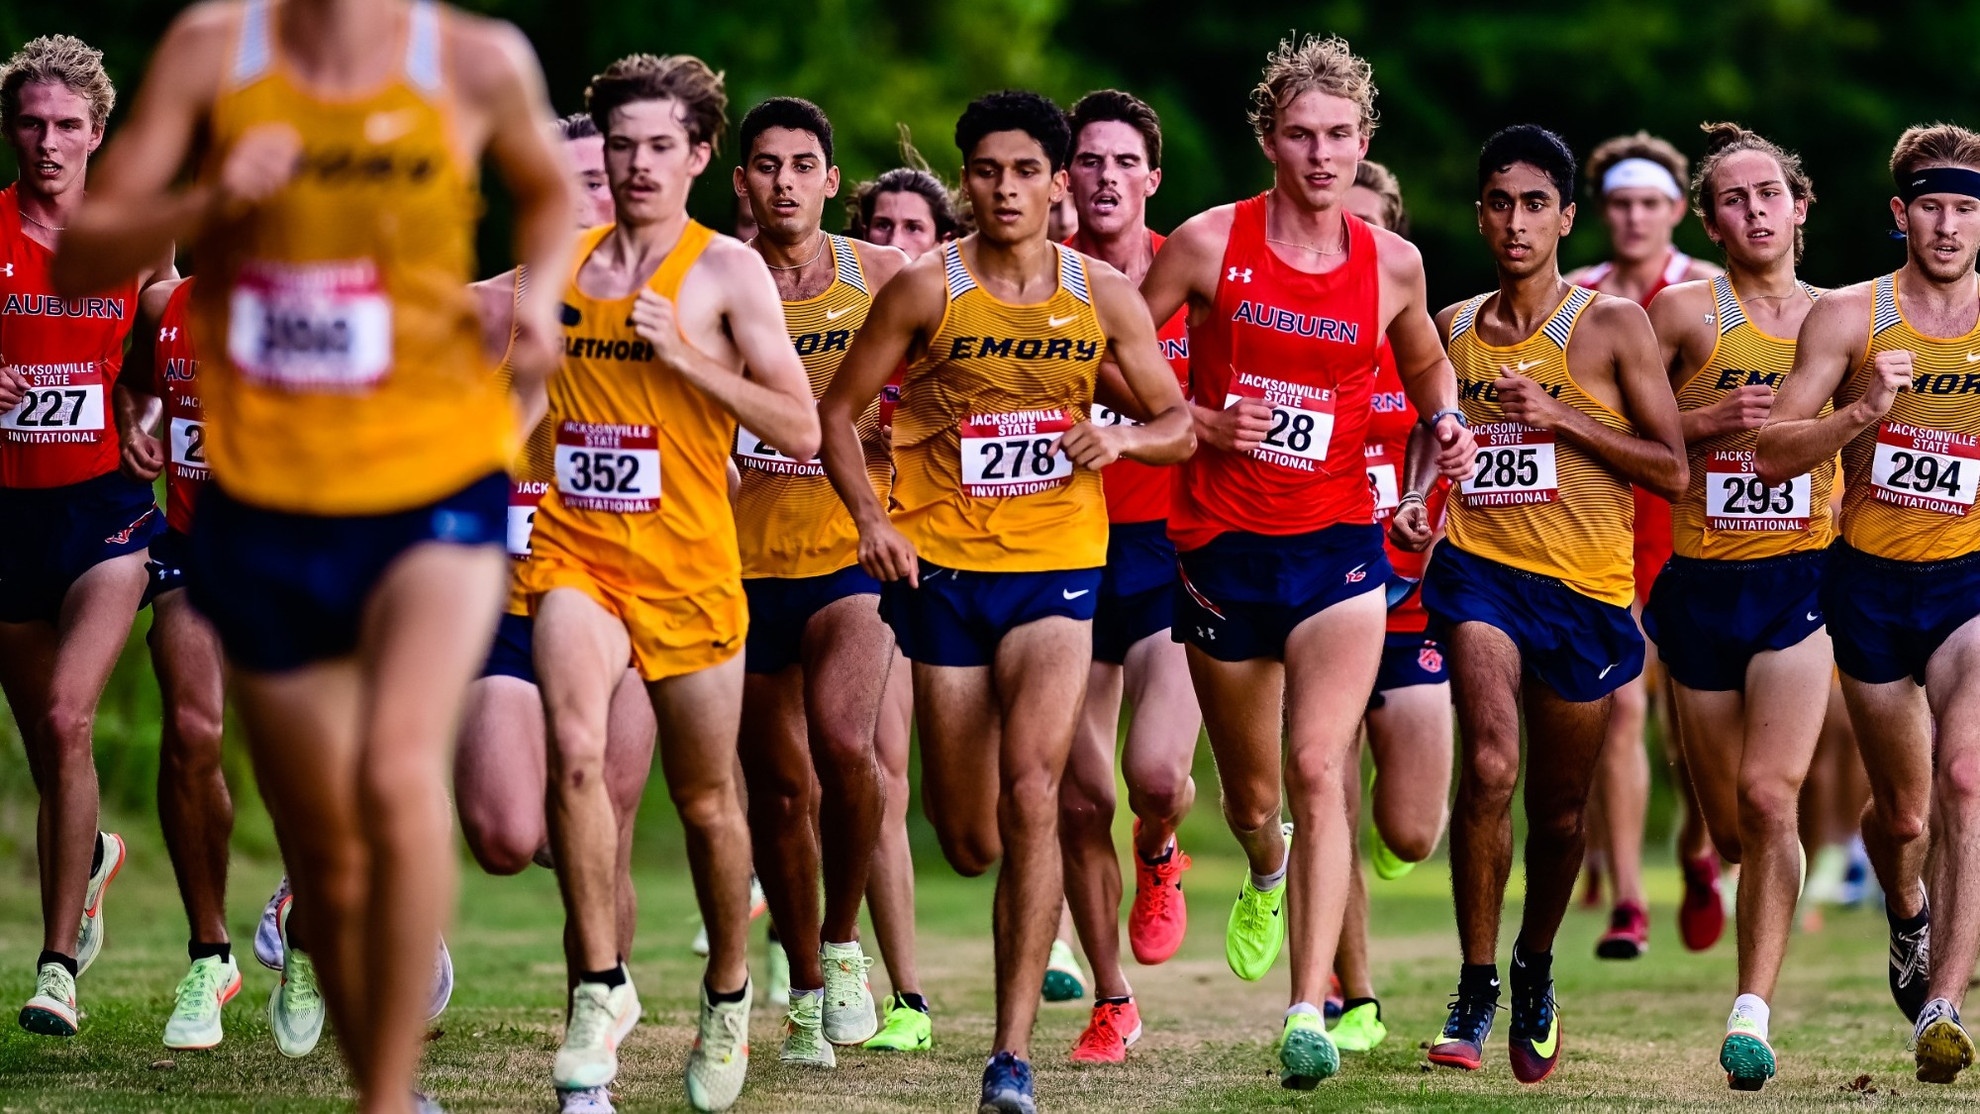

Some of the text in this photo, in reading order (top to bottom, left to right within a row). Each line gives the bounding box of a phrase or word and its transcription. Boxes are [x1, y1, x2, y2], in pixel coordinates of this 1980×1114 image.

[2, 294, 124, 319] AUBURN
[1232, 300, 1359, 345] AUBURN
[949, 336, 1097, 361] EMORY
[33, 374, 70, 386] STATE
[1239, 372, 1330, 401] JACKSONVILLE
[16, 390, 87, 426] 227
[1264, 390, 1302, 407] STATE
[970, 409, 1063, 426] JACKSONVILLE
[998, 422, 1036, 436] STATE
[8, 431, 97, 443] INVITATIONAL
[1261, 409, 1315, 452] 28
[1490, 433, 1523, 445] STATE
[1887, 422, 1977, 446] JACKSONVILLE
[1912, 438, 1949, 454] STATE
[743, 457, 827, 476] INVITATIONA
[980, 438, 1055, 480] 278
[1247, 448, 1315, 472] TATIONAL
[1473, 448, 1539, 488] 285
[569, 451, 641, 493] 352
[1886, 451, 1961, 497] 294
[1468, 493, 1551, 507] INVITATIONAL
[1722, 477, 1794, 515] 293
[1876, 488, 1965, 516] INVITATIONAL
[1714, 519, 1803, 531] INVITATIONAL
